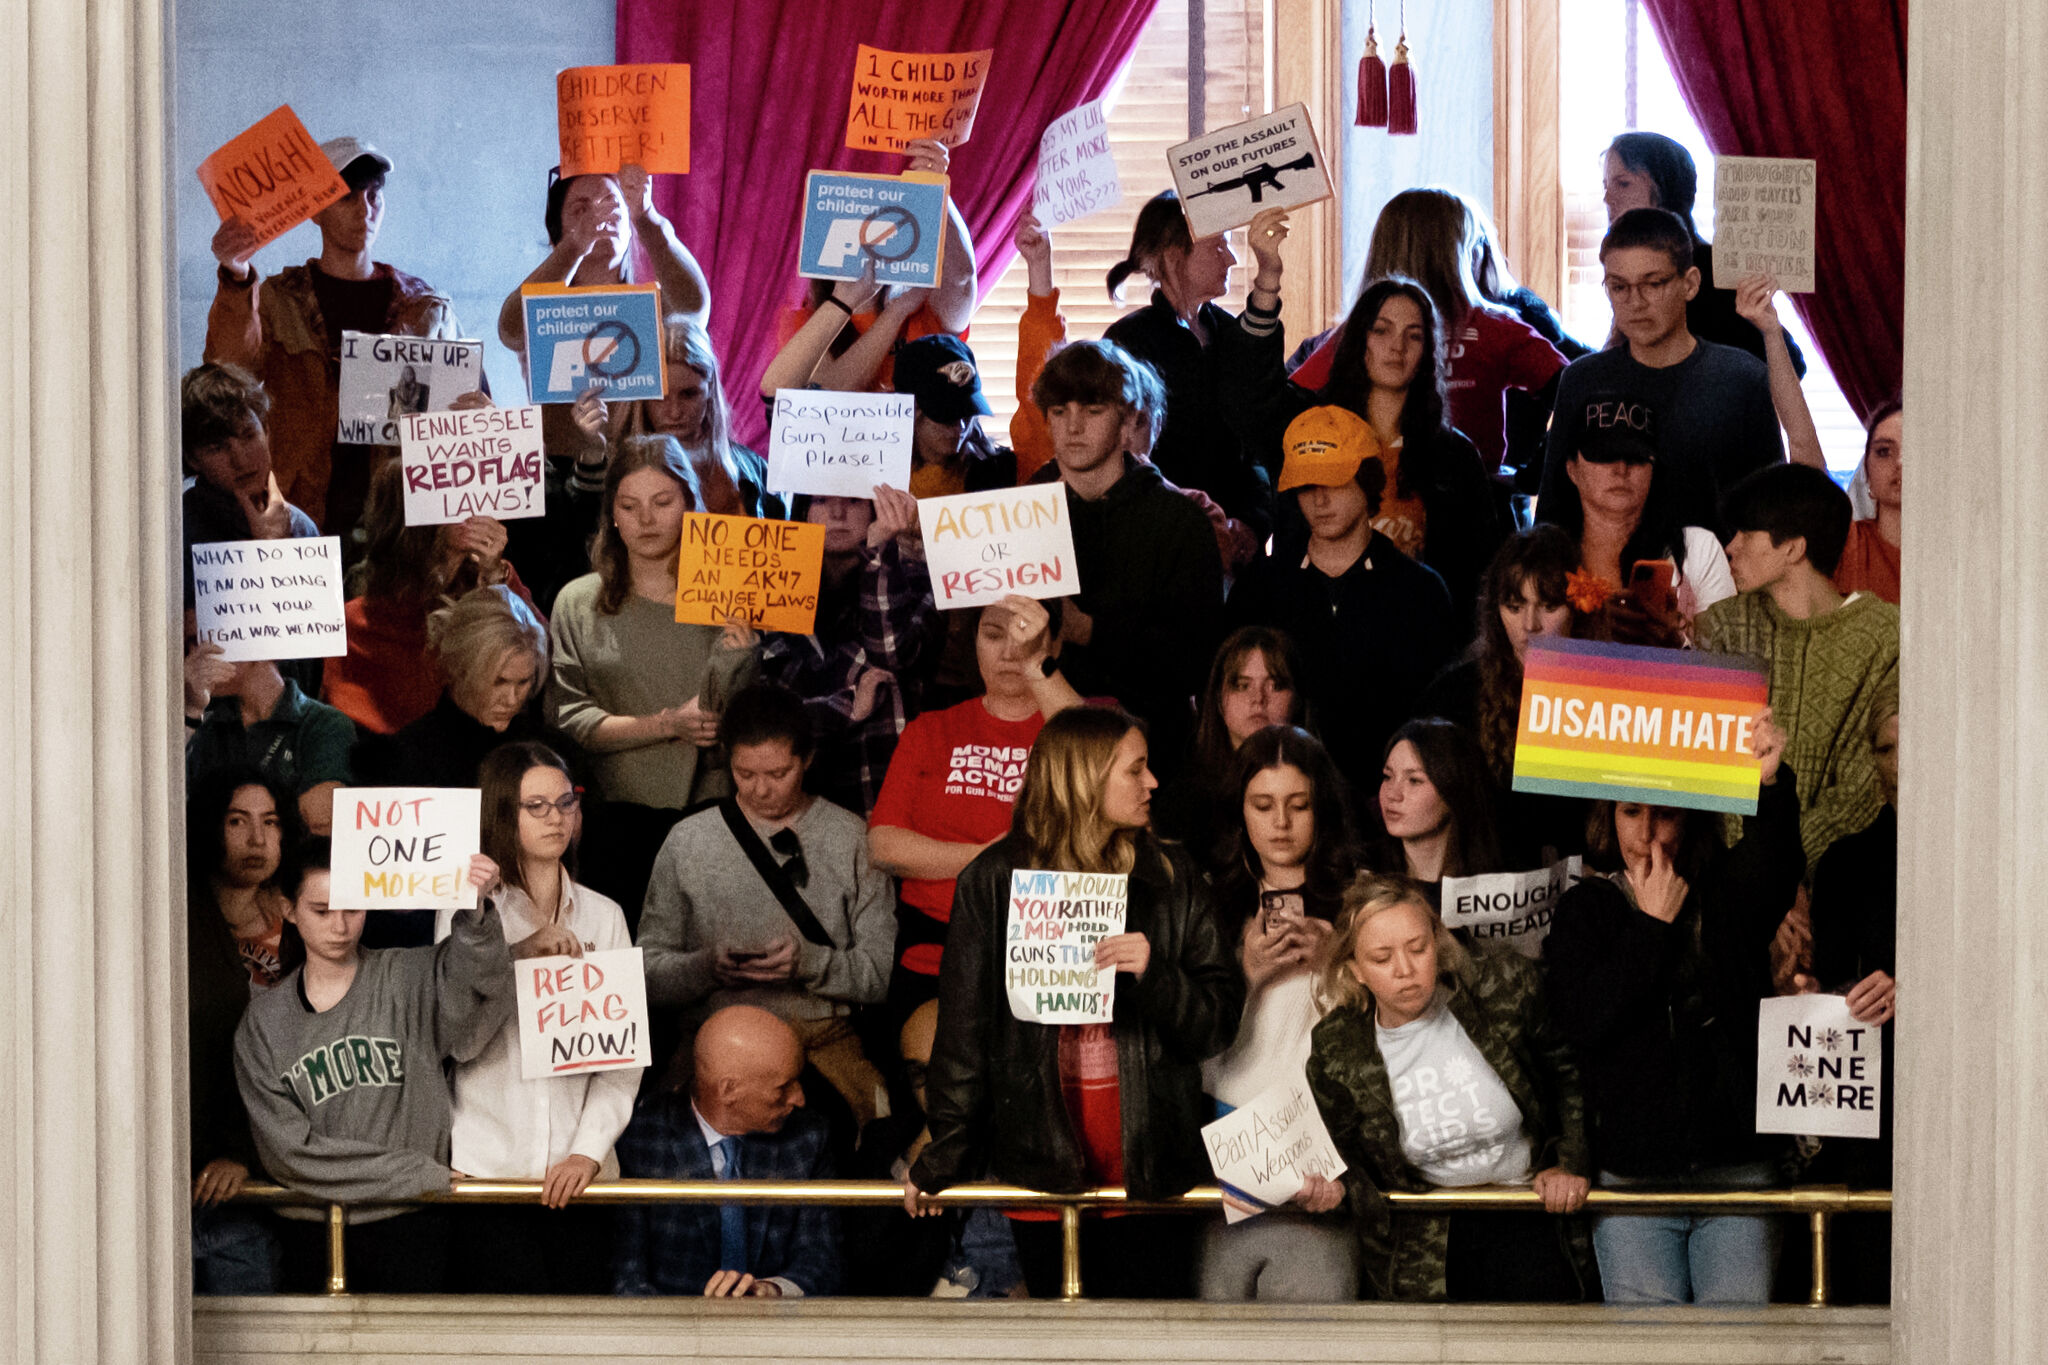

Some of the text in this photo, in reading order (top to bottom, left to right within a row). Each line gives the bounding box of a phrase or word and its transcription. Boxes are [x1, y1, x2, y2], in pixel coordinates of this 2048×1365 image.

[867, 54, 980, 82] 1 CHILD IS
[559, 70, 667, 103] CHILDREN
[857, 82, 908, 100] WORTH
[912, 91, 945, 104] MORE
[566, 105, 651, 129] DESERVE
[852, 102, 899, 130] ALL
[905, 112, 938, 132] THE
[1060, 114, 1078, 138] MY
[863, 135, 878, 145] IN
[1178, 118, 1297, 168] STOP THE ASSAULT
[1190, 137, 1297, 180] ON OUR FUTURES
[818, 184, 907, 202] protect our
[1056, 169, 1092, 200] YOUR
[890, 260, 929, 274] guns
[536, 304, 619, 322] protect our
[345, 339, 359, 359] I
[373, 339, 433, 363] GREW
[617, 375, 656, 390] guns
[776, 399, 914, 426] Responsible
[340, 419, 375, 442] WHY
[402, 408, 534, 442] TENNESSEE
[781, 425, 901, 445] Gun Laws
[427, 438, 512, 461] WANTS
[443, 484, 534, 518] LAWS!
[934, 493, 1059, 543] ACTION
[690, 518, 799, 551] NO ONE
[193, 544, 329, 566] WHAT DO YOU
[703, 548, 782, 568] NEEDS
[981, 542, 1012, 563] OR
[240, 576, 265, 590] ON
[271, 575, 327, 589] DOING
[693, 569, 802, 590] AN AK47
[942, 555, 1062, 600] RESIGN
[214, 602, 262, 616] WITH
[681, 589, 817, 611] CHANGE LAWS
[711, 605, 765, 623] NOW
[250, 626, 282, 638] WAR
[1528, 693, 1754, 755] DISARM HATE
[952, 744, 1028, 762] MOMS
[949, 756, 1028, 778] DEMA
[945, 785, 963, 795] FOR
[965, 786, 985, 797] GUN
[946, 769, 1023, 793] ACTIO
[356, 797, 434, 830] NOT
[368, 833, 447, 866] ONE
[364, 867, 462, 900] MORE!
[1013, 873, 1128, 899] WHY WOULD
[1457, 878, 1562, 914] ENOUGH
[1013, 898, 1125, 924] YOU RATHER
[1009, 921, 1110, 941] 2 MEN HOLD
[1473, 908, 1554, 939] LREAD
[1010, 945, 1057, 964] GUNS
[533, 963, 604, 999] RED
[1009, 967, 1099, 990] HOLDING
[537, 993, 628, 1034] FLAG
[1036, 992, 1110, 1018] HANDS!
[551, 1022, 637, 1064] NOW!
[1210, 1087, 1309, 1170] Ban Assault
[1251, 1131, 1313, 1185] Weapons
